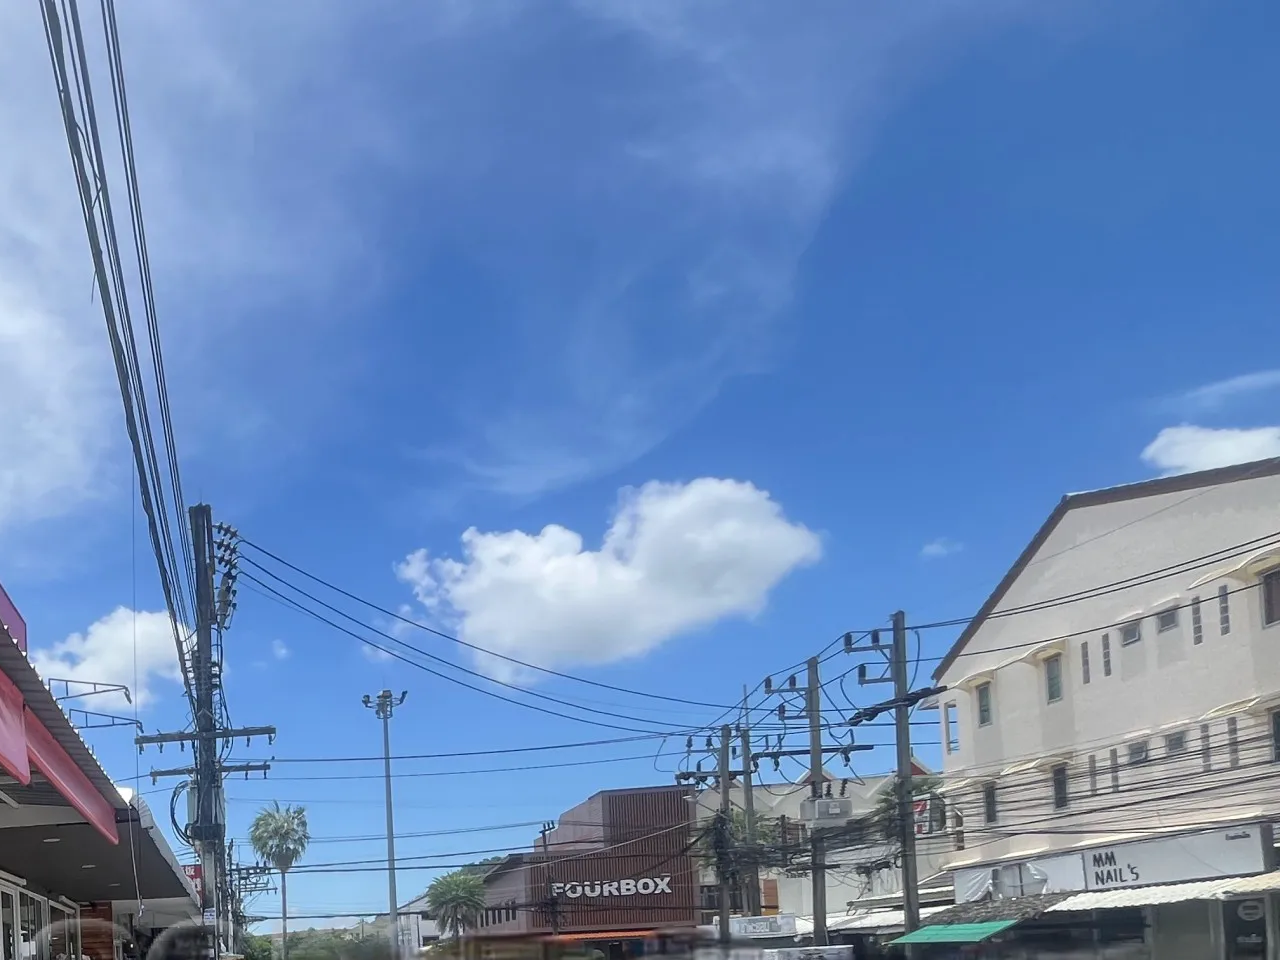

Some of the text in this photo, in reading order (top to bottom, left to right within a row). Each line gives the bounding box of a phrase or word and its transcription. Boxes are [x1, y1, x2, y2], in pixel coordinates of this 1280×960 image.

[1092, 851, 1117, 868] MM
[1094, 863, 1140, 886] NAIL'S
[551, 876, 672, 898] FOURBOX
